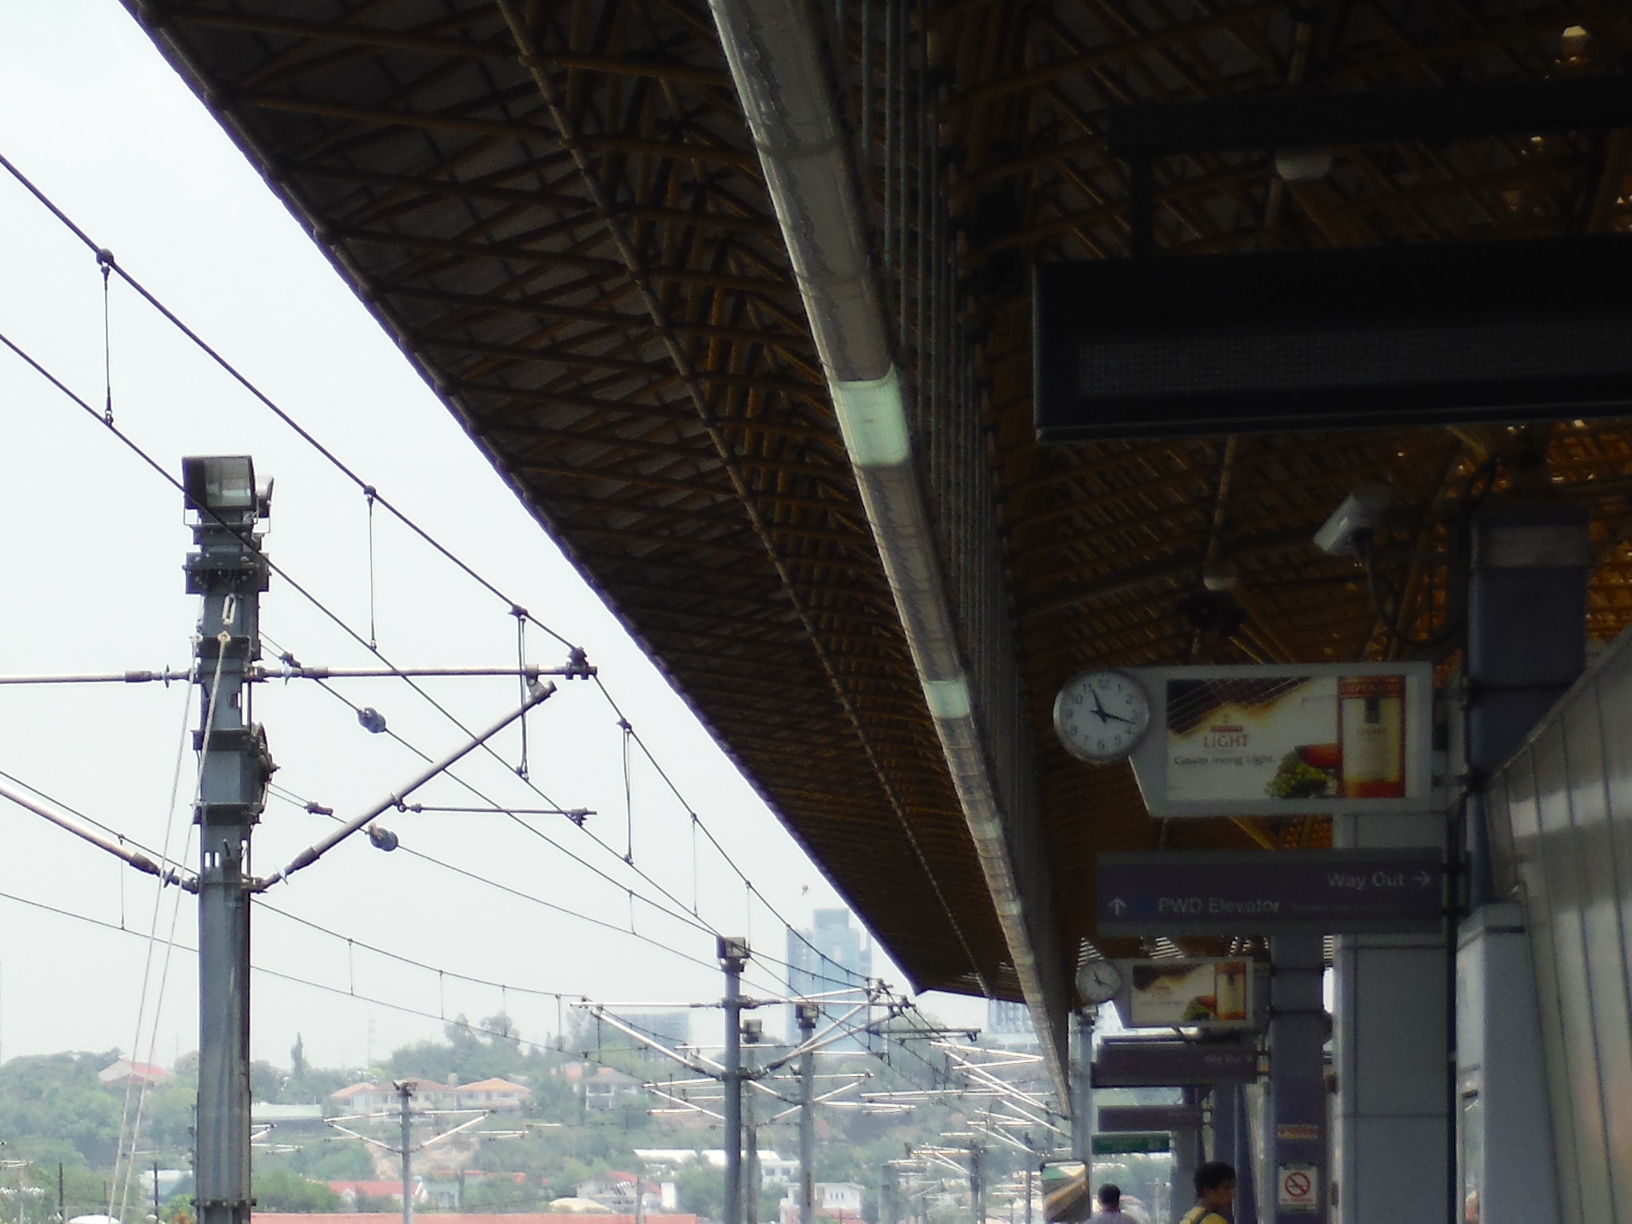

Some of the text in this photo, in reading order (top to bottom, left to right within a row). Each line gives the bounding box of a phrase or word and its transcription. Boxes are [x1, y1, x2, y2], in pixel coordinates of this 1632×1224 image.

[1203, 734, 1249, 748] LIGHT
[1328, 870, 1405, 890] Way Out
[1158, 898, 1202, 913] PWD
[1208, 898, 1281, 913] Elevator
